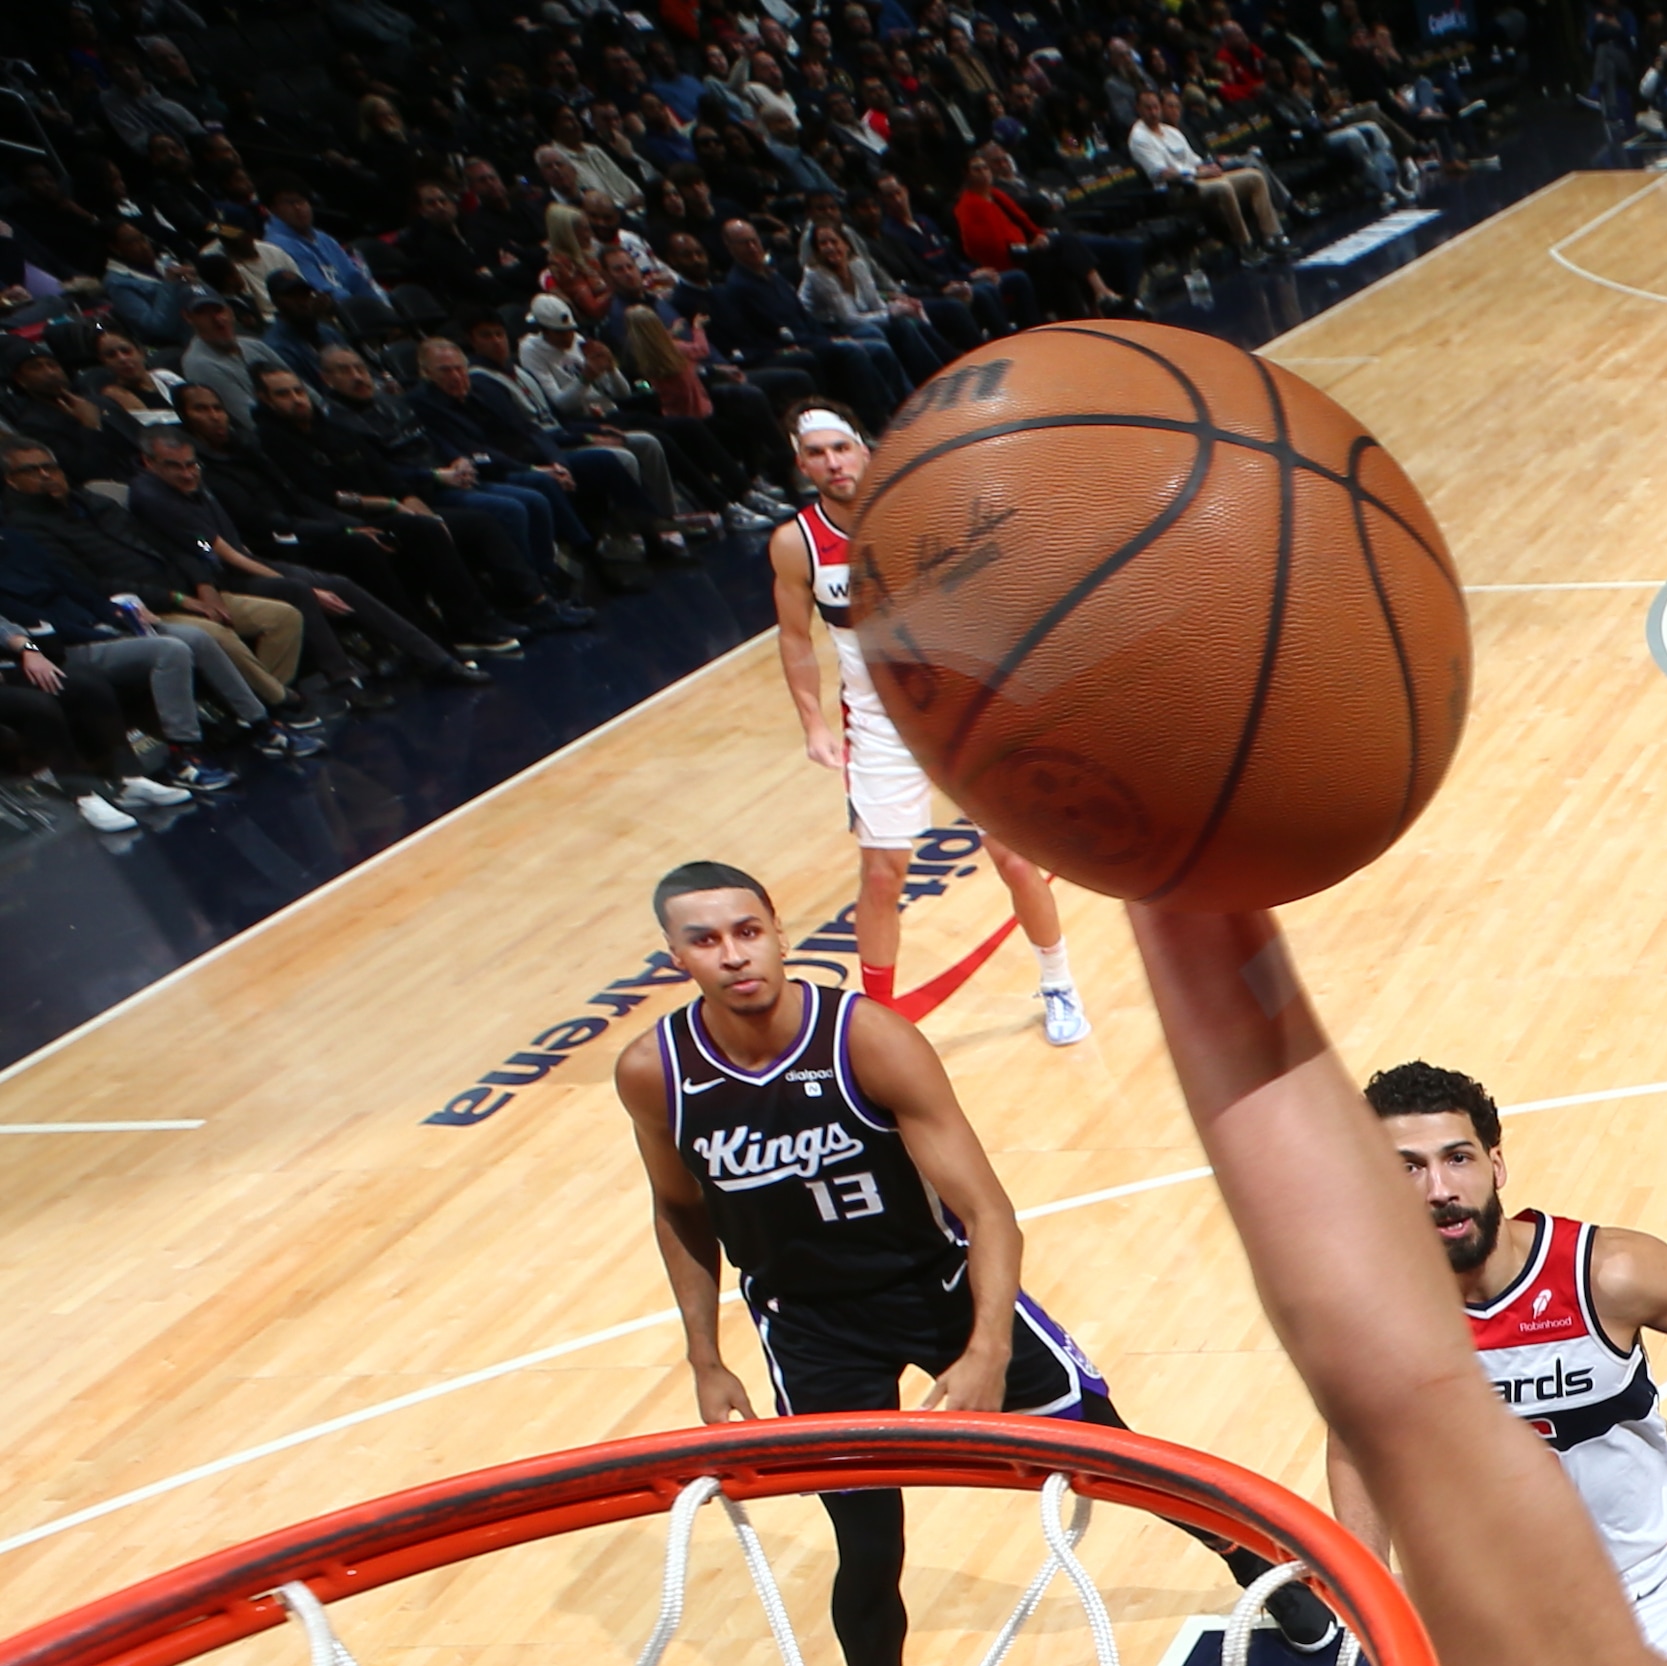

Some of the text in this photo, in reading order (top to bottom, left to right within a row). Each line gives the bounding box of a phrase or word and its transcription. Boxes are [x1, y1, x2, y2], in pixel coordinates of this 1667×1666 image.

[420, 950, 692, 1127] Arena
[694, 1121, 864, 1192] Kings
[805, 1172, 884, 1222] 13
[1519, 1316, 1573, 1333] Robinhood
[1490, 1357, 1595, 1403] ards
